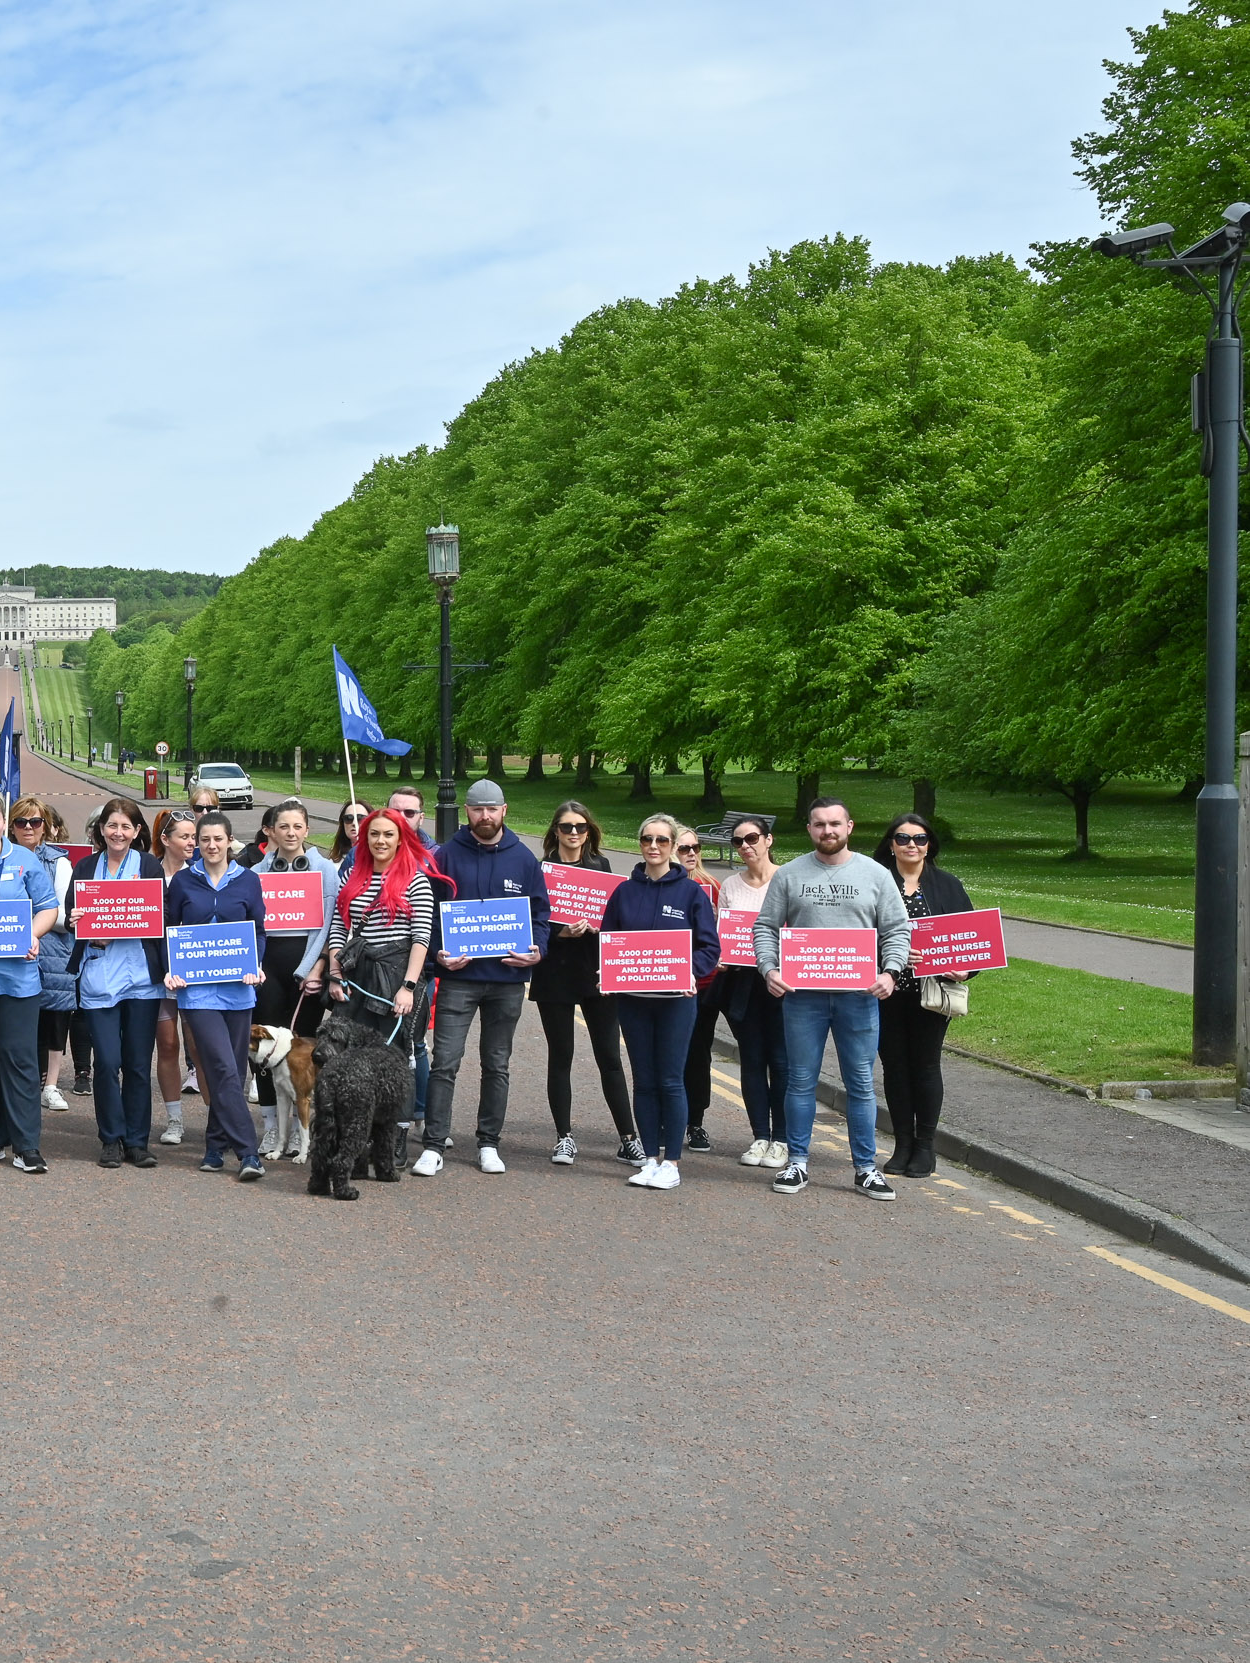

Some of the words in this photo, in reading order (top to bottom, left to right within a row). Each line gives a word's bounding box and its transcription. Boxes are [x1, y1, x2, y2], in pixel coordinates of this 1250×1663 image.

[556, 883, 577, 892] 3,000
[799, 884, 825, 897] Jack
[829, 885, 859, 895] Wills
[572, 892, 586, 901] ARE
[453, 916, 489, 924] HEALTH
[482, 923, 524, 932] PRIORITY
[951, 931, 977, 940] NEED
[180, 940, 215, 949] HEALTH
[218, 938, 242, 946] CARE
[481, 943, 517, 951] YOURS?
[922, 946, 950, 955] MORE
[952, 941, 991, 952] NURSES
[208, 948, 249, 957] PRIORITY
[932, 957, 953, 966] NOT
[956, 953, 991, 963] FEWER
